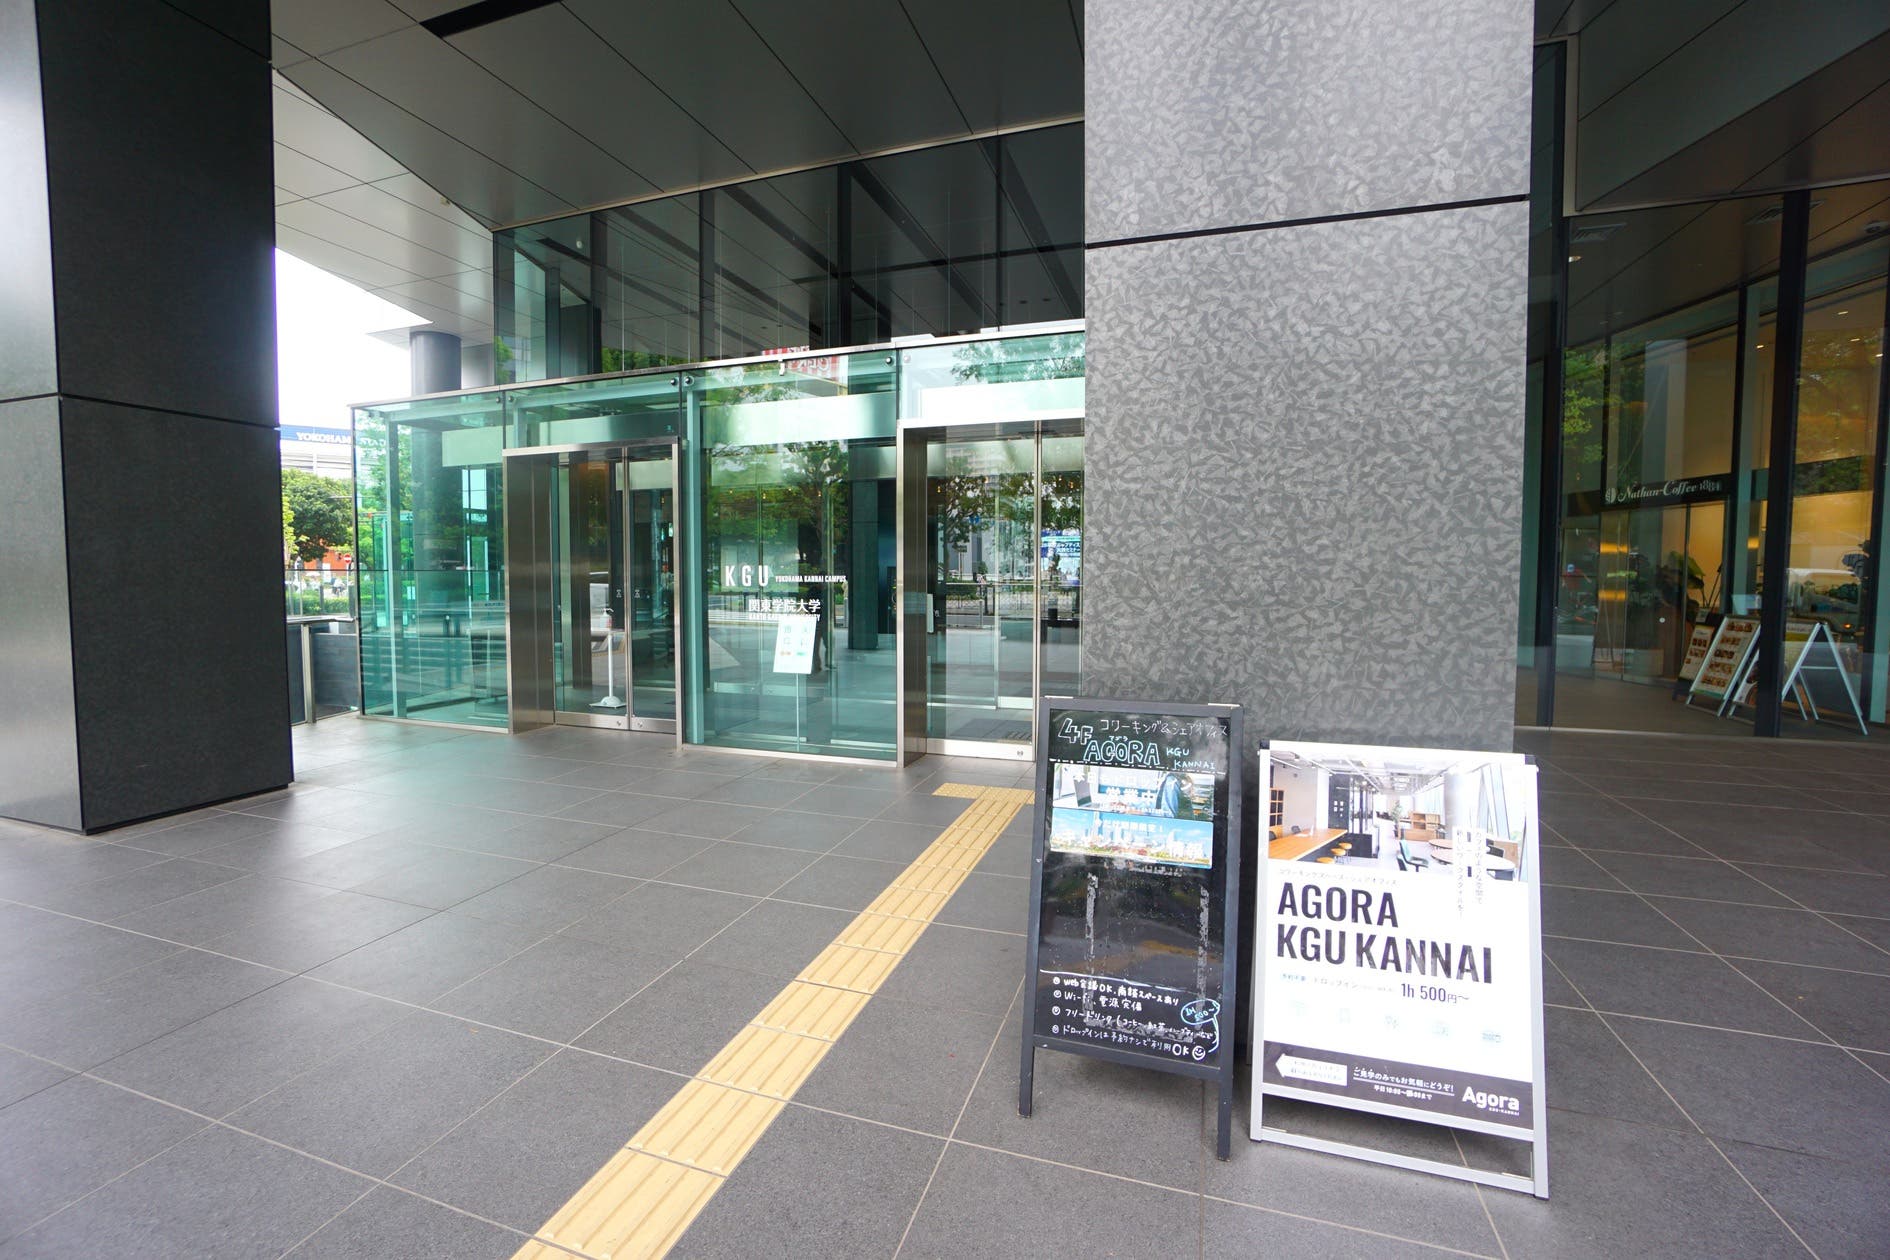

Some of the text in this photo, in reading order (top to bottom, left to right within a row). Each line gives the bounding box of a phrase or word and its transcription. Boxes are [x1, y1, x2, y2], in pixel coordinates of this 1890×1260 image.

[1617, 486, 1659, 502] Nathan
[1663, 480, 1697, 496] Coffee
[725, 565, 847, 587] KGU YOKOHAMA KANNAI CAMPUS
[748, 599, 821, 613] 関東学院大学
[1058, 717, 1093, 745] 4F
[1083, 740, 1160, 766] AGORA
[1166, 747, 1190, 757] KGU
[1174, 759, 1216, 770] KANNAI
[1277, 881, 1399, 928] AGORA
[1277, 923, 1492, 984] KGU KANNAI
[1401, 983, 1415, 998] 1h
[1462, 1086, 1520, 1110] Agora
